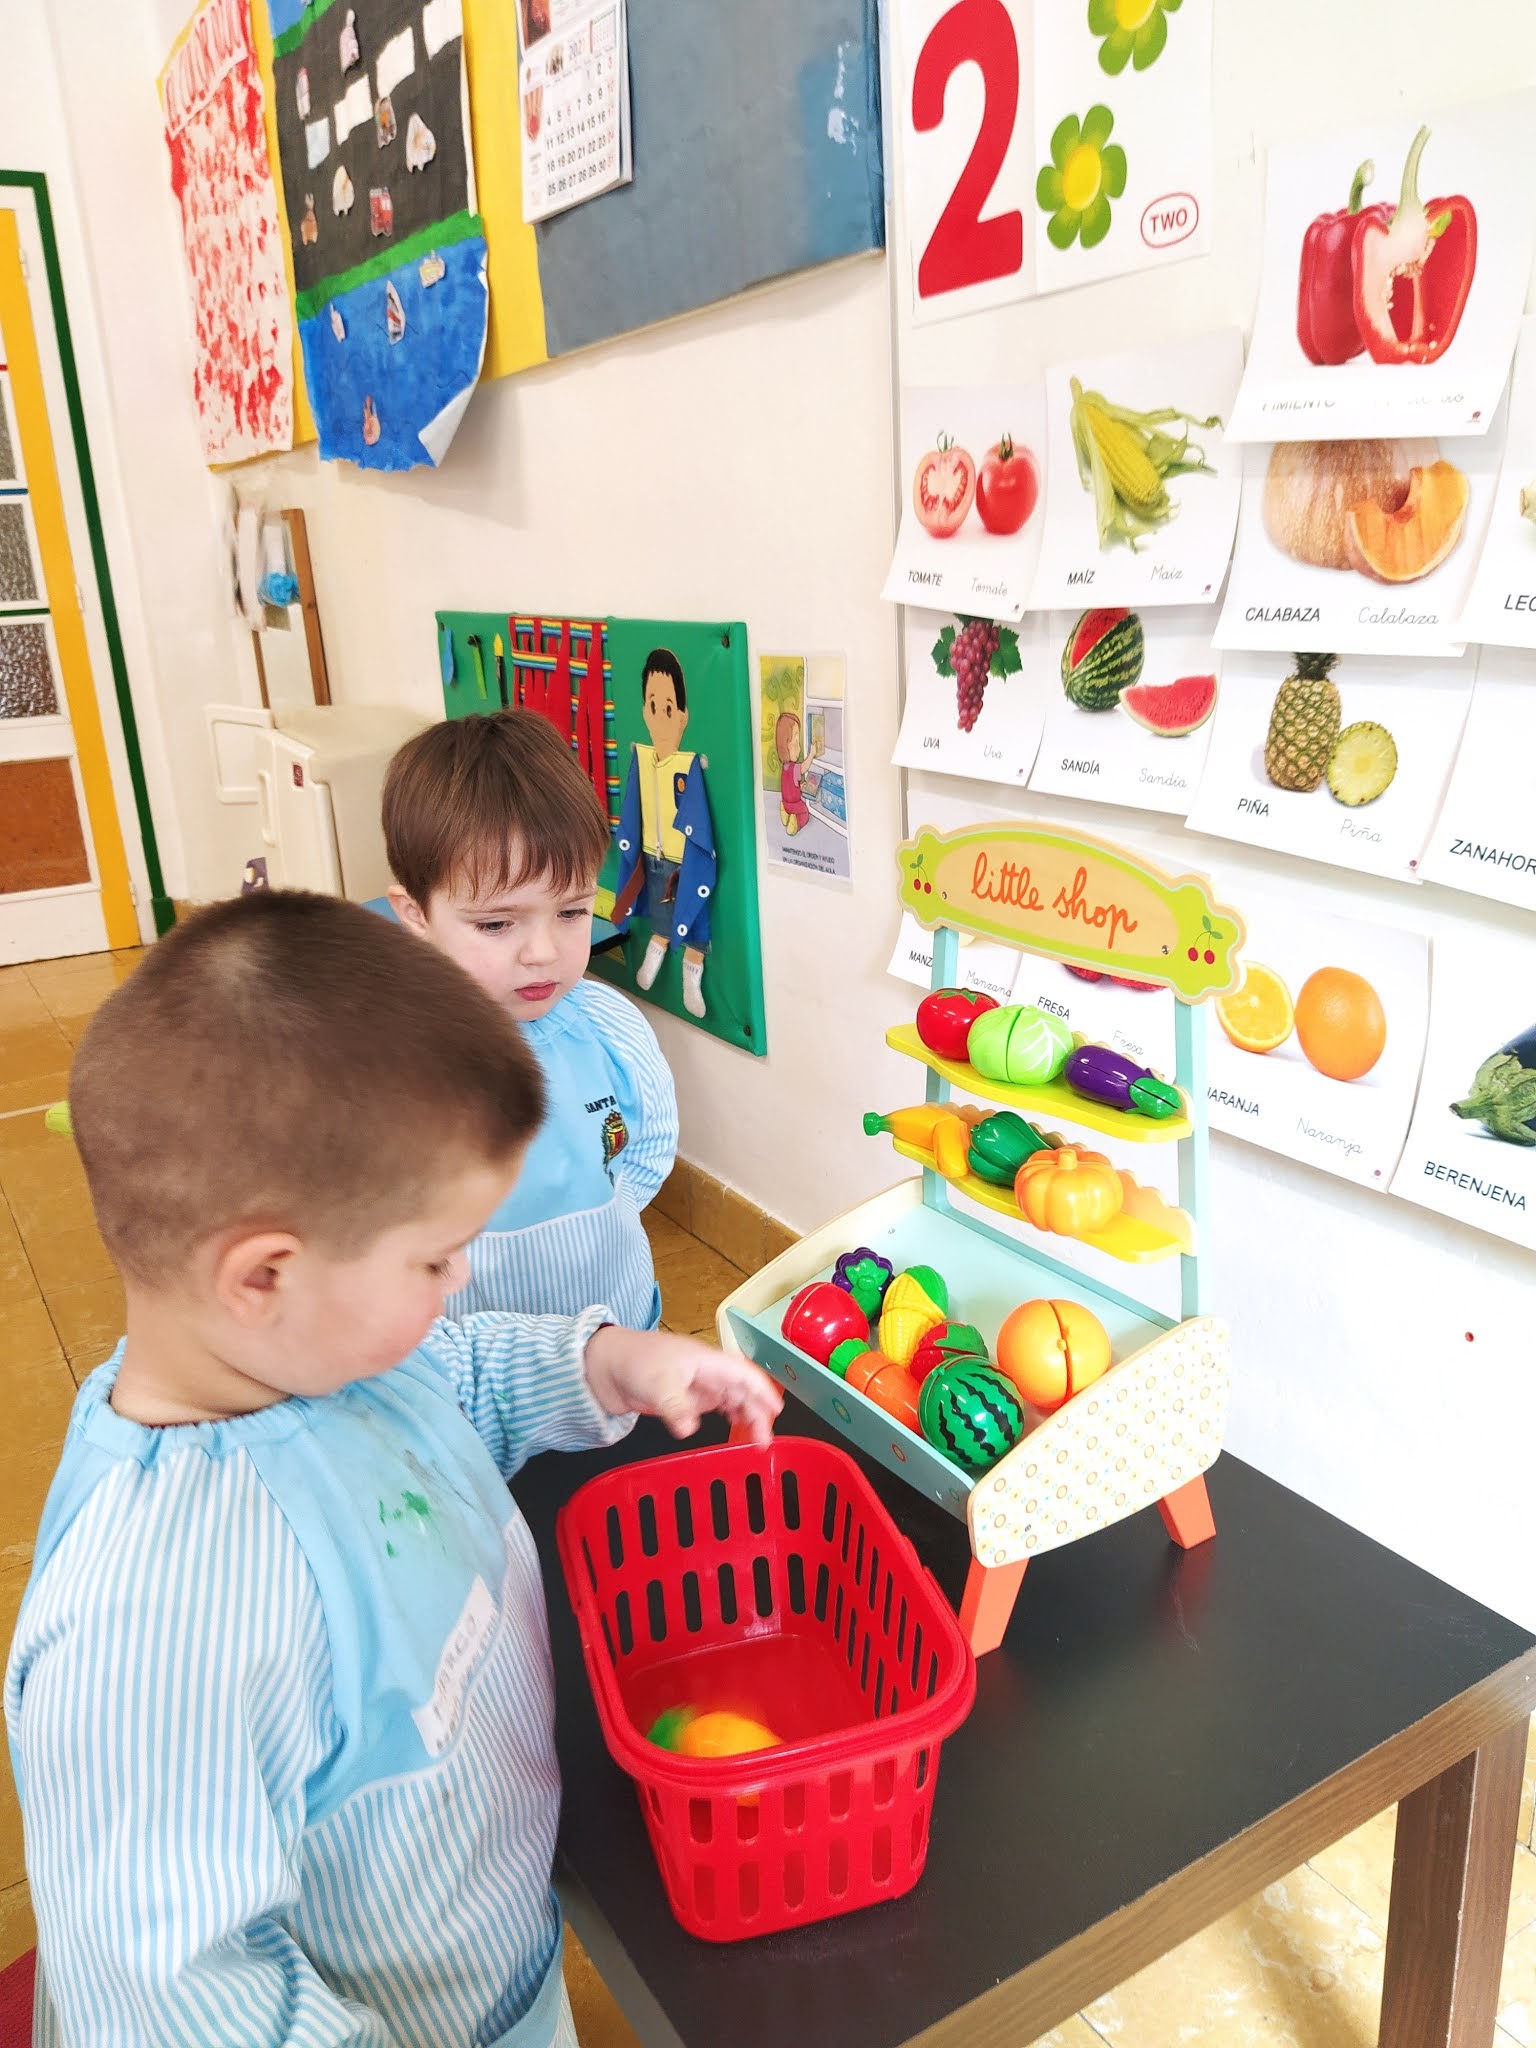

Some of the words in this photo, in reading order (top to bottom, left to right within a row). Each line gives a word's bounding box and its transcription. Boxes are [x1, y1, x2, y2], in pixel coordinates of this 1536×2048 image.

[911, 0, 1024, 300] 2
[1149, 207, 1188, 235] TWO
[907, 569, 943, 587] TOMATE
[970, 575, 1009, 597] Tomate
[1066, 568, 1096, 586] MAÍZ
[1245, 607, 1321, 623] CALABAZA
[1358, 606, 1439, 625] Calabaza
[923, 736, 941, 750] UVA
[982, 743, 1003, 760] Uva
[1060, 758, 1100, 776] SANDÍA
[1236, 797, 1270, 817] PIÑA
[1339, 818, 1383, 843] Piña
[1449, 838, 1536, 876] ZANAHOR
[970, 851, 1044, 912] little
[1052, 865, 1139, 950] shop
[908, 950, 933, 968] MANZ
[965, 969, 1012, 998] Manzana
[1036, 996, 1071, 1020] FRESA
[1111, 1029, 1145, 1057] Fresa
[1296, 1116, 1364, 1157] Naranja
[1423, 1160, 1527, 1211] BERENJENA
